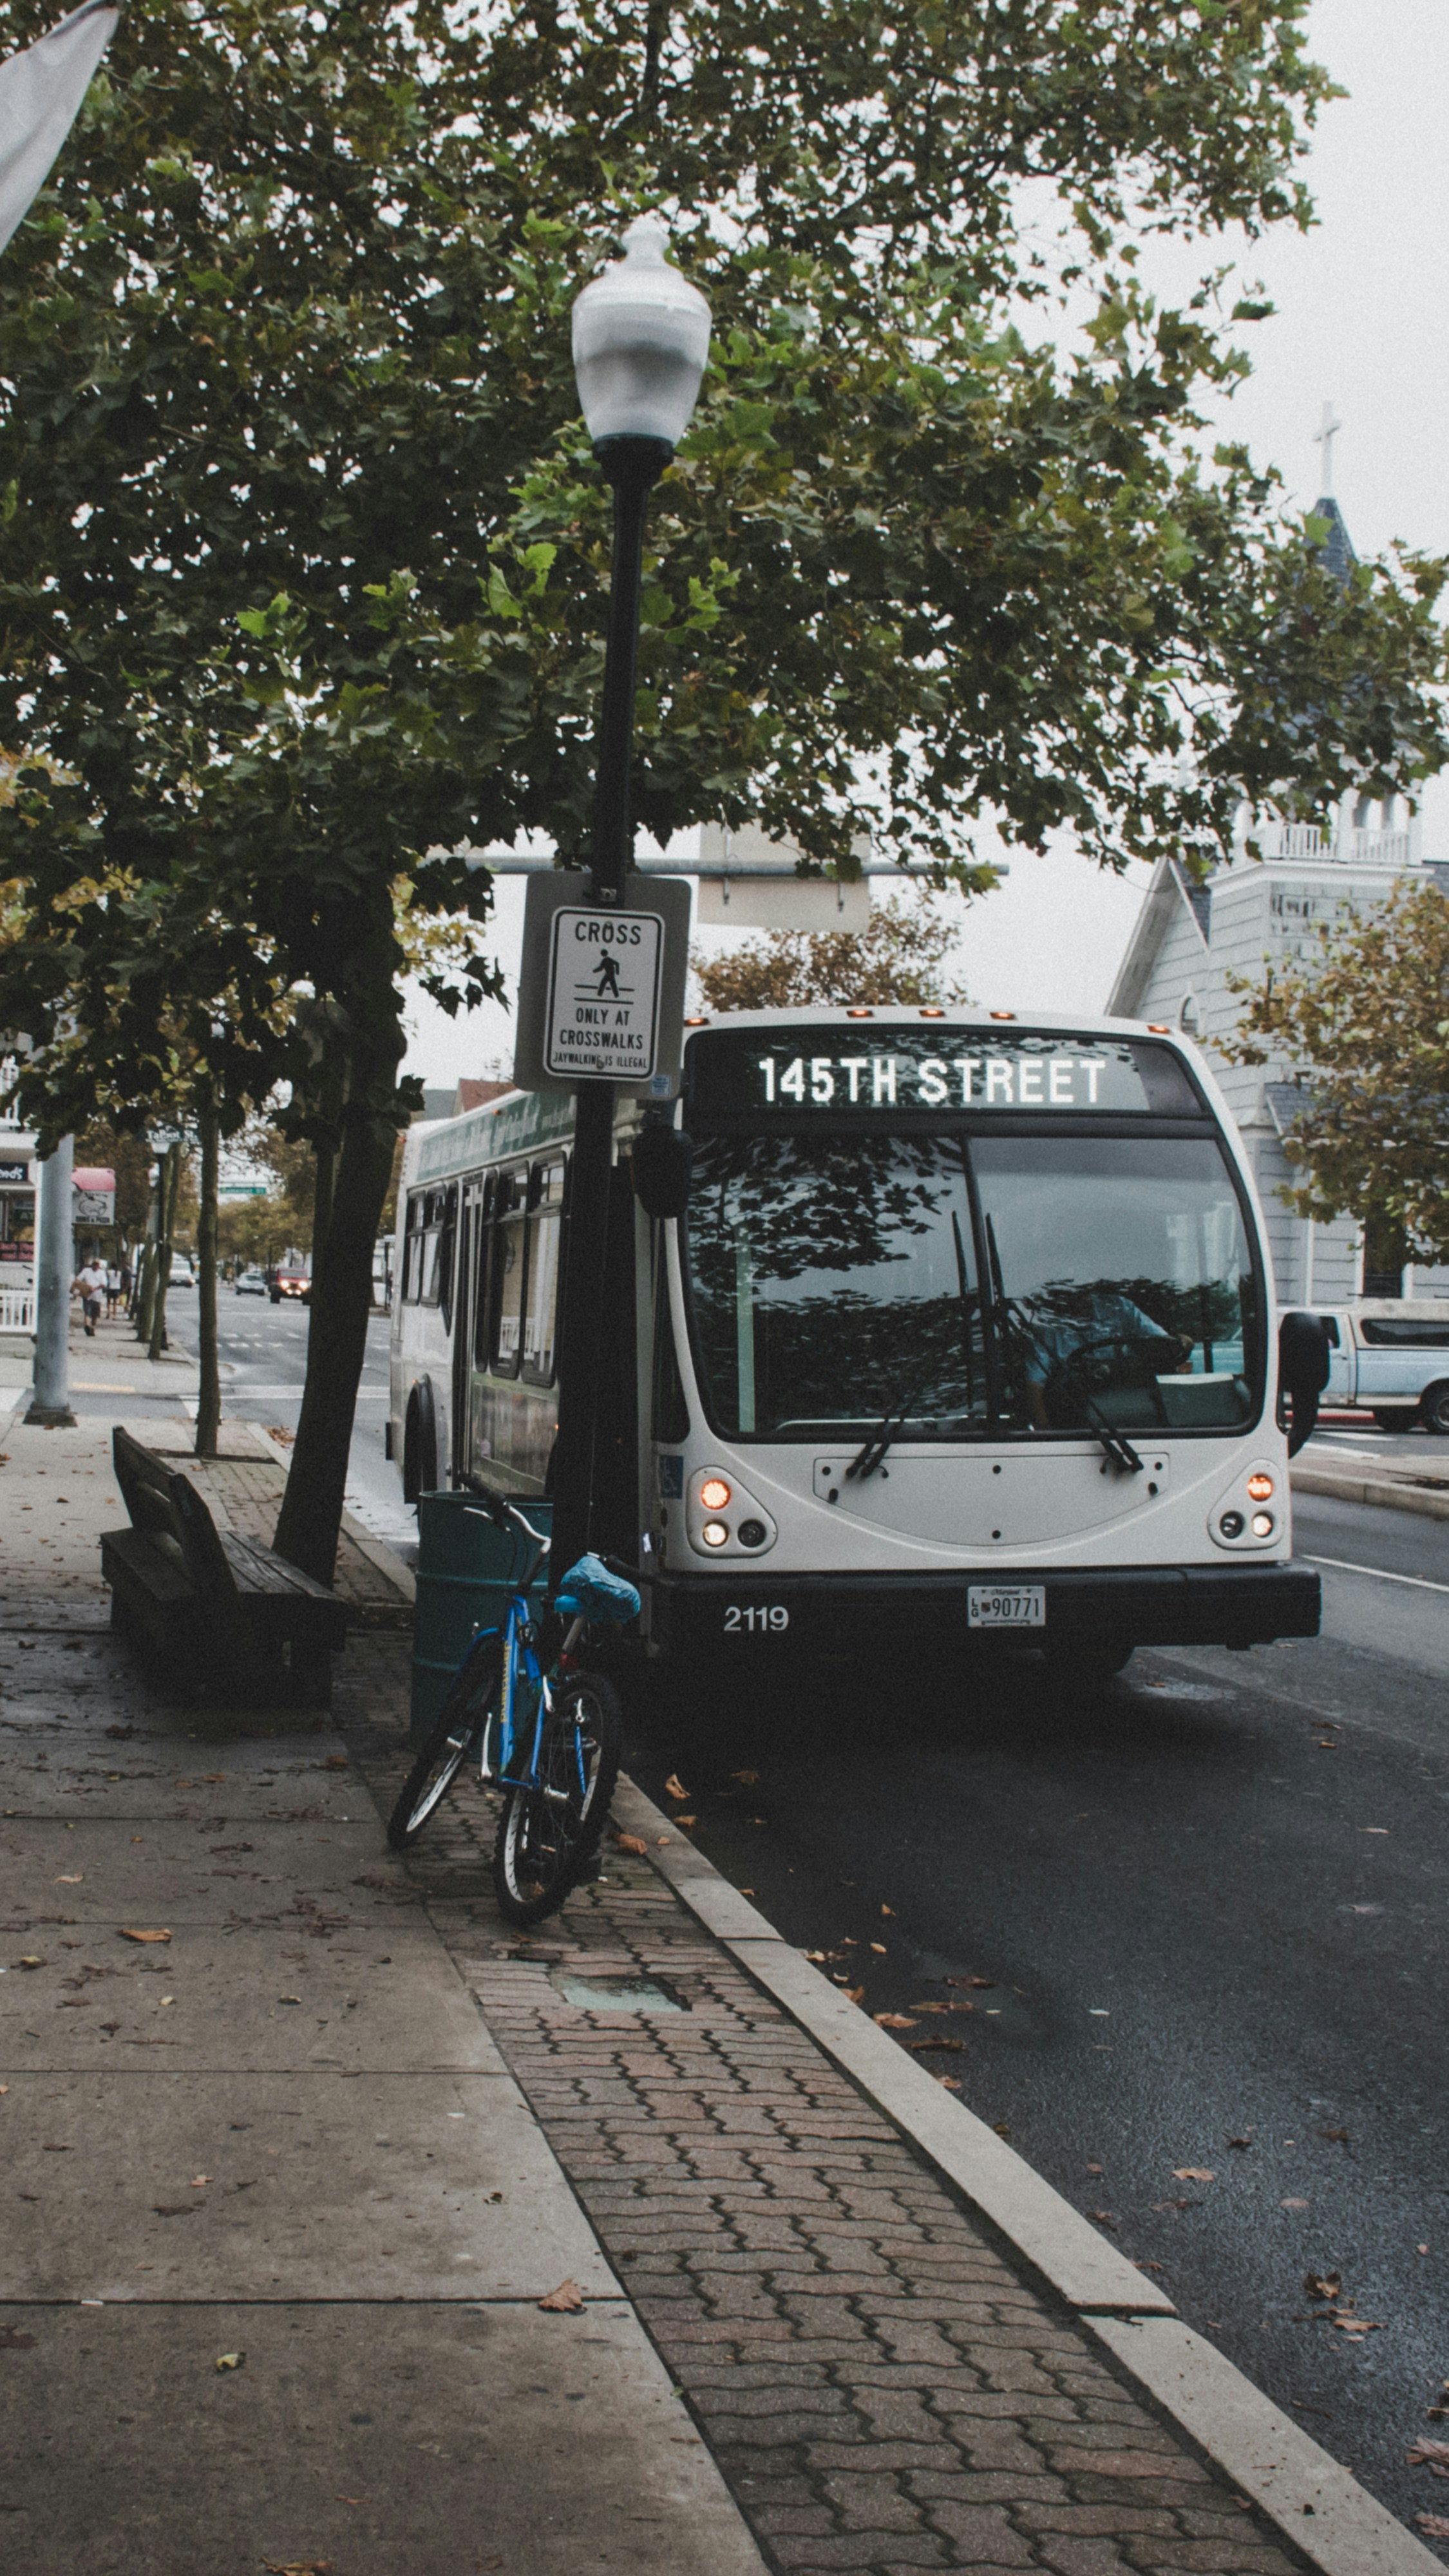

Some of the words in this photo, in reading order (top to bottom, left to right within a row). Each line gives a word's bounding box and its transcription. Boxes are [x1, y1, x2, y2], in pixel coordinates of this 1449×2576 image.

[575, 921, 641, 945] CROSS
[576, 1007, 609, 1025] ONLY
[615, 1010, 630, 1026] AT
[560, 1029, 643, 1050] CROSSWALKS
[553, 1052, 605, 1066] JAYWALKING
[605, 1056, 613, 1066] IS
[616, 1057, 647, 1068] ILLEGAL
[759, 1057, 896, 1102] 145TH
[918, 1058, 1112, 1103] STREET
[992, 1598, 1039, 1617] 90771
[724, 1606, 789, 1631] 2119
